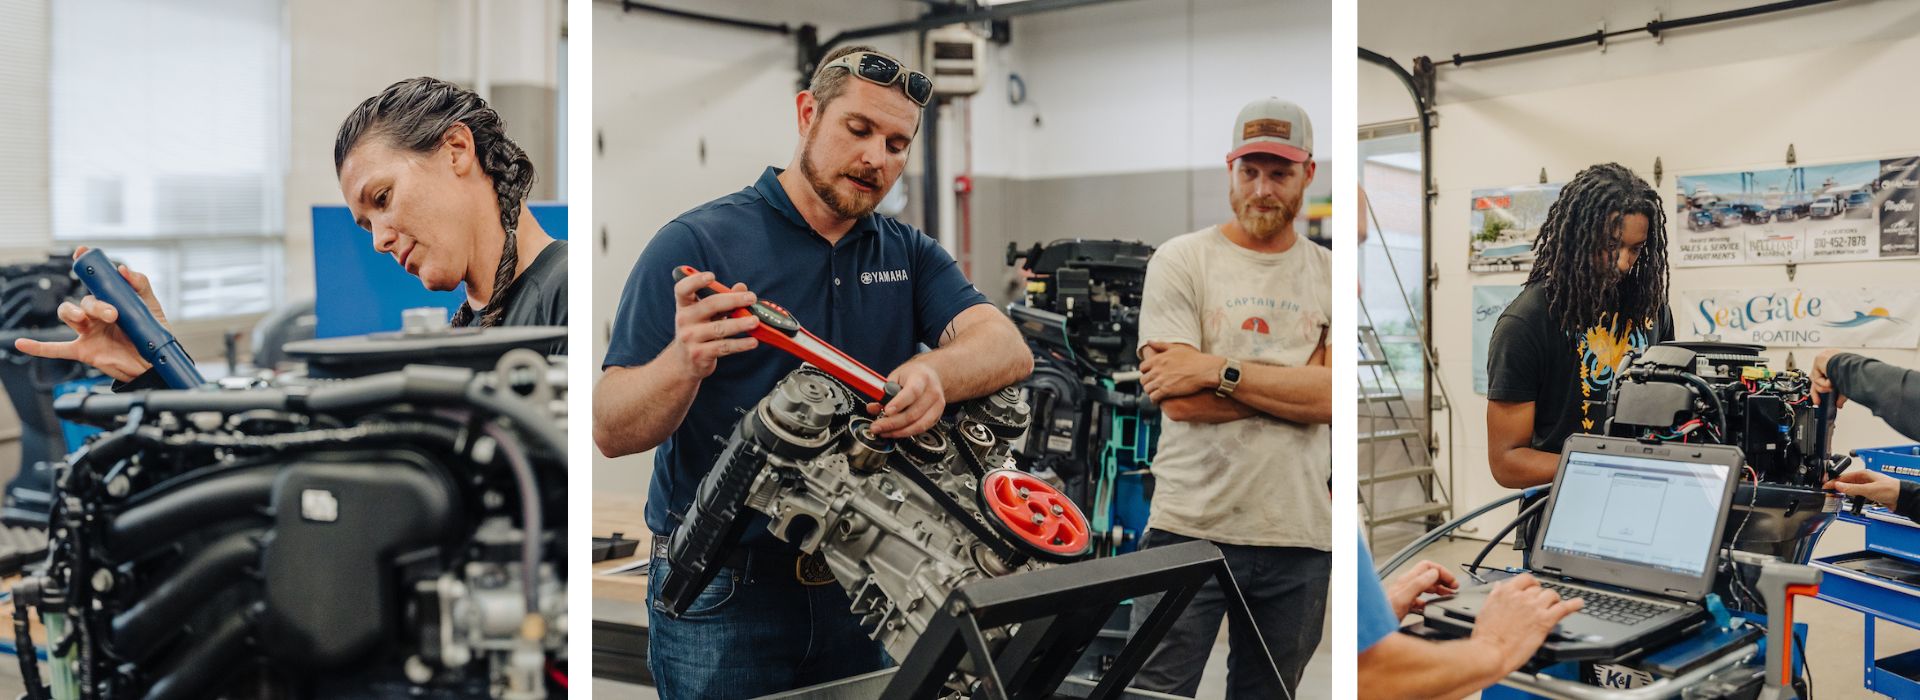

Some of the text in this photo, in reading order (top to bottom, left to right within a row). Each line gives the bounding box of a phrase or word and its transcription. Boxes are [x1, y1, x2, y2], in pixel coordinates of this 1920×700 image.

[1680, 243, 1701, 252] SALES
[1711, 242, 1739, 251] SERVICE
[871, 269, 909, 283] YAMAHA
[1226, 297, 1300, 312] CAPTAIN FIN
[1693, 292, 1822, 337] SeaGate
[1752, 330, 1821, 343] BOATING
